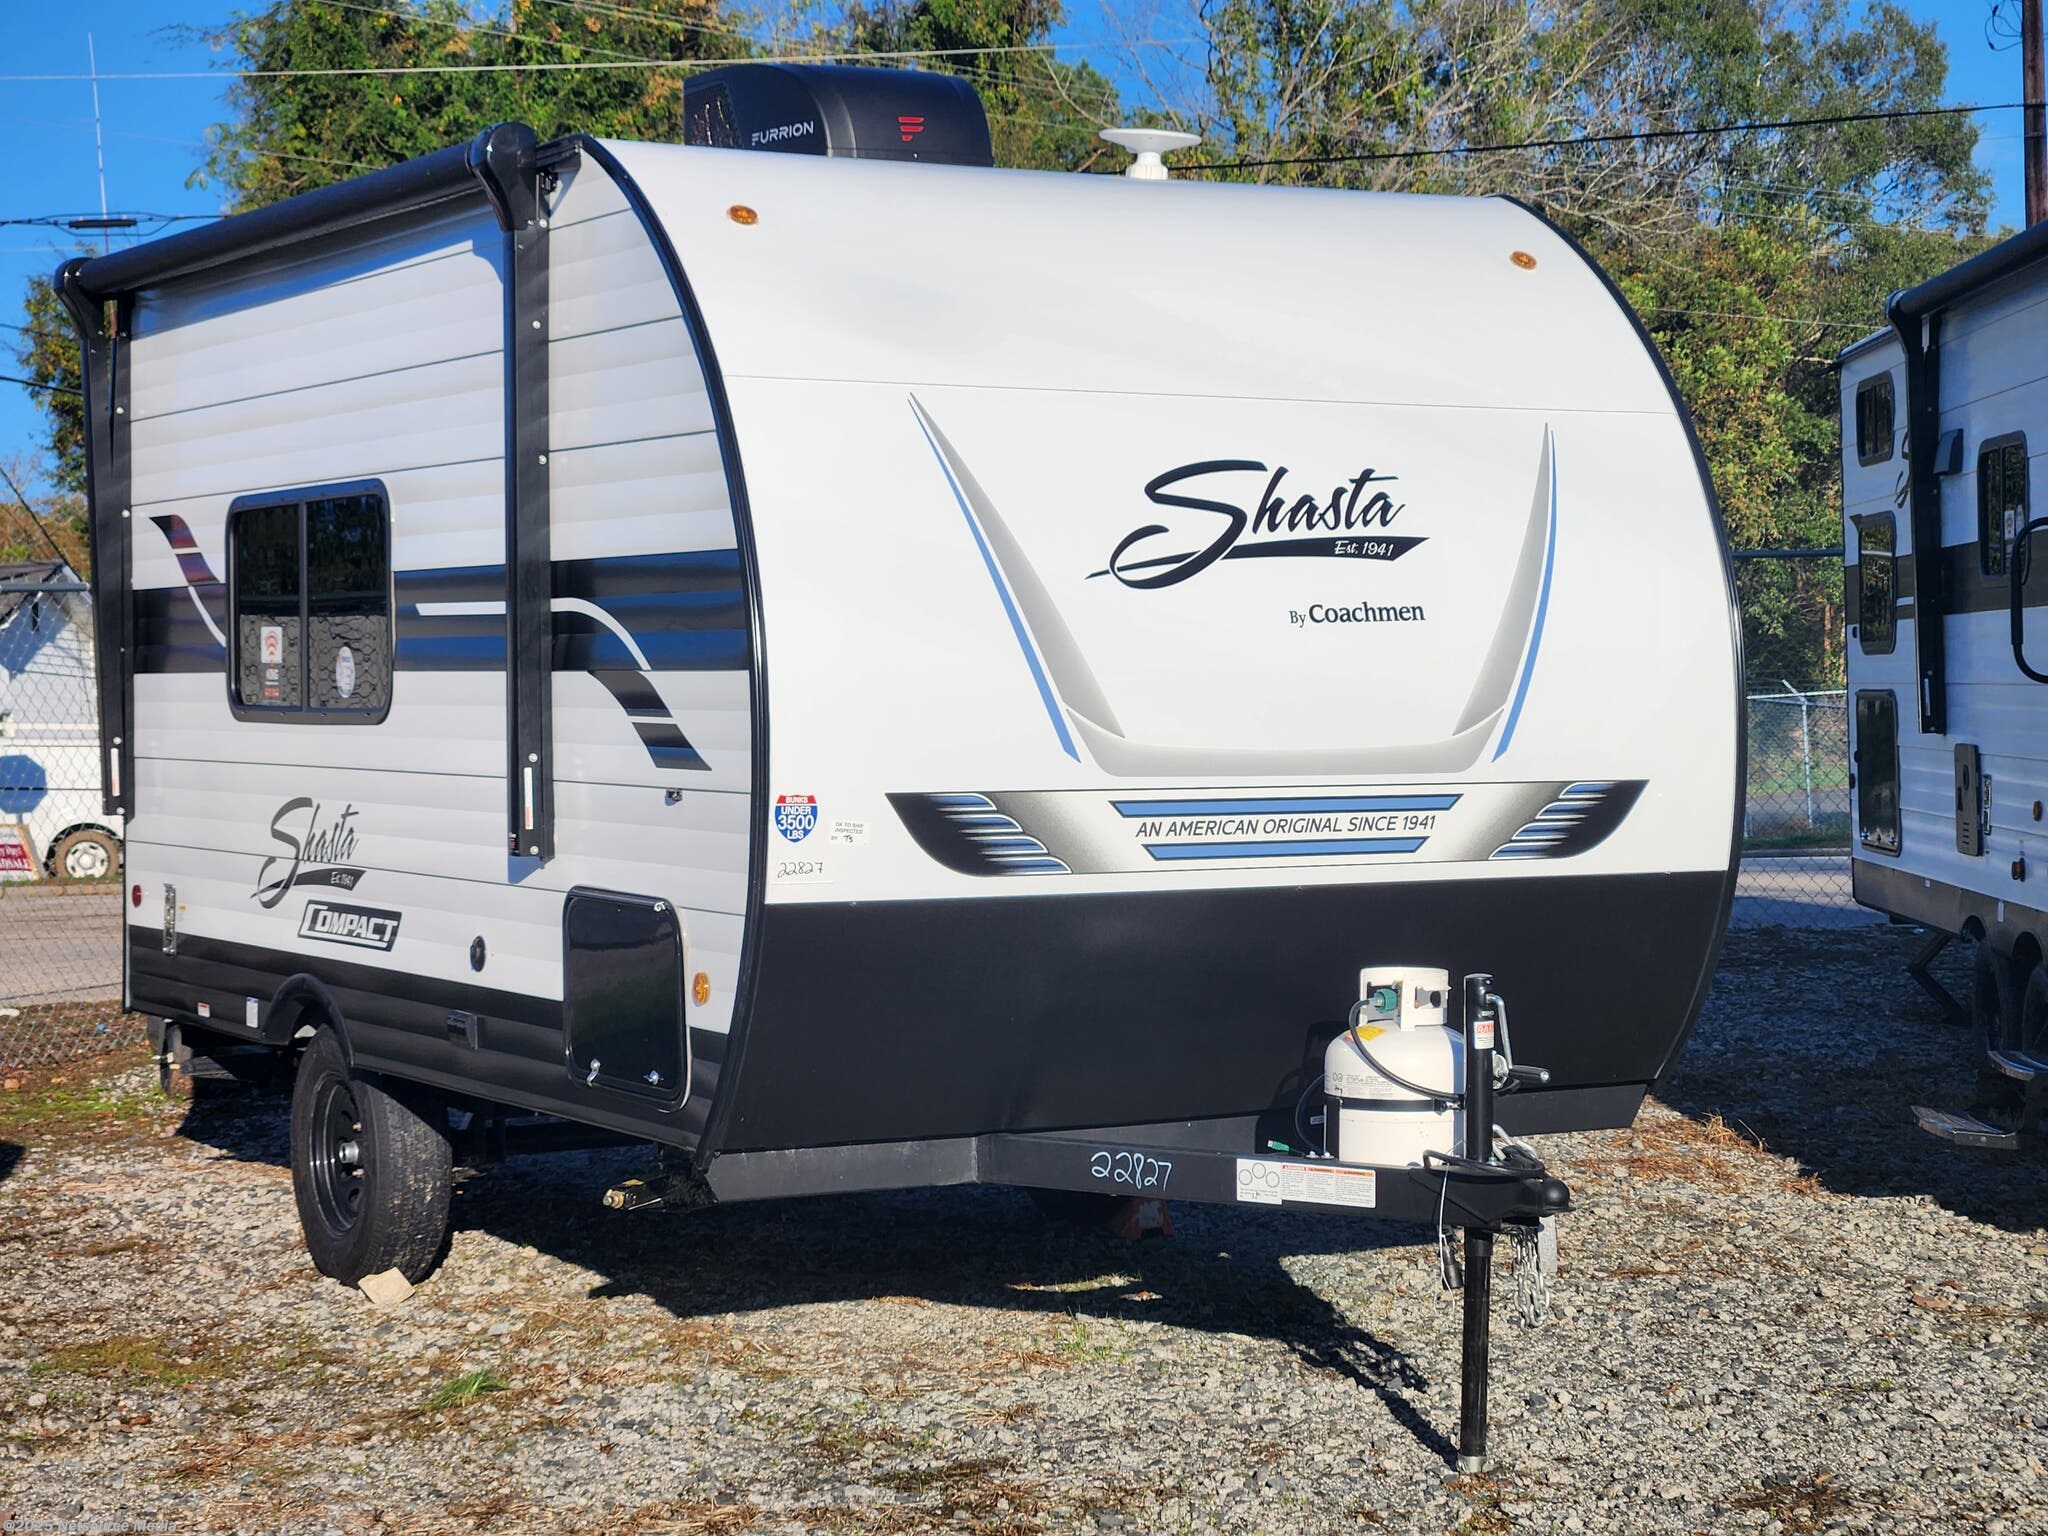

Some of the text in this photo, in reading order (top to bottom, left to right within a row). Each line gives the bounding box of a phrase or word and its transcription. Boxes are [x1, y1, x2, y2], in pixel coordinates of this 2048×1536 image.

[751, 121, 814, 147] FURRION
[1108, 459, 1406, 590] Shasta
[1334, 540, 1394, 557] Est. 1941
[1289, 600, 1426, 628] By Coachmen
[778, 815, 814, 830] 3500
[781, 806, 811, 815] UNDER
[787, 830, 804, 840] LBS
[1135, 815, 1436, 838] AN AMERICAN ORIGINAL SINCE 1941
[257, 797, 360, 910] Shasta
[777, 861, 823, 878] 22827
[300, 903, 399, 948] COMPACT
[1090, 1151, 1172, 1192] 22827
